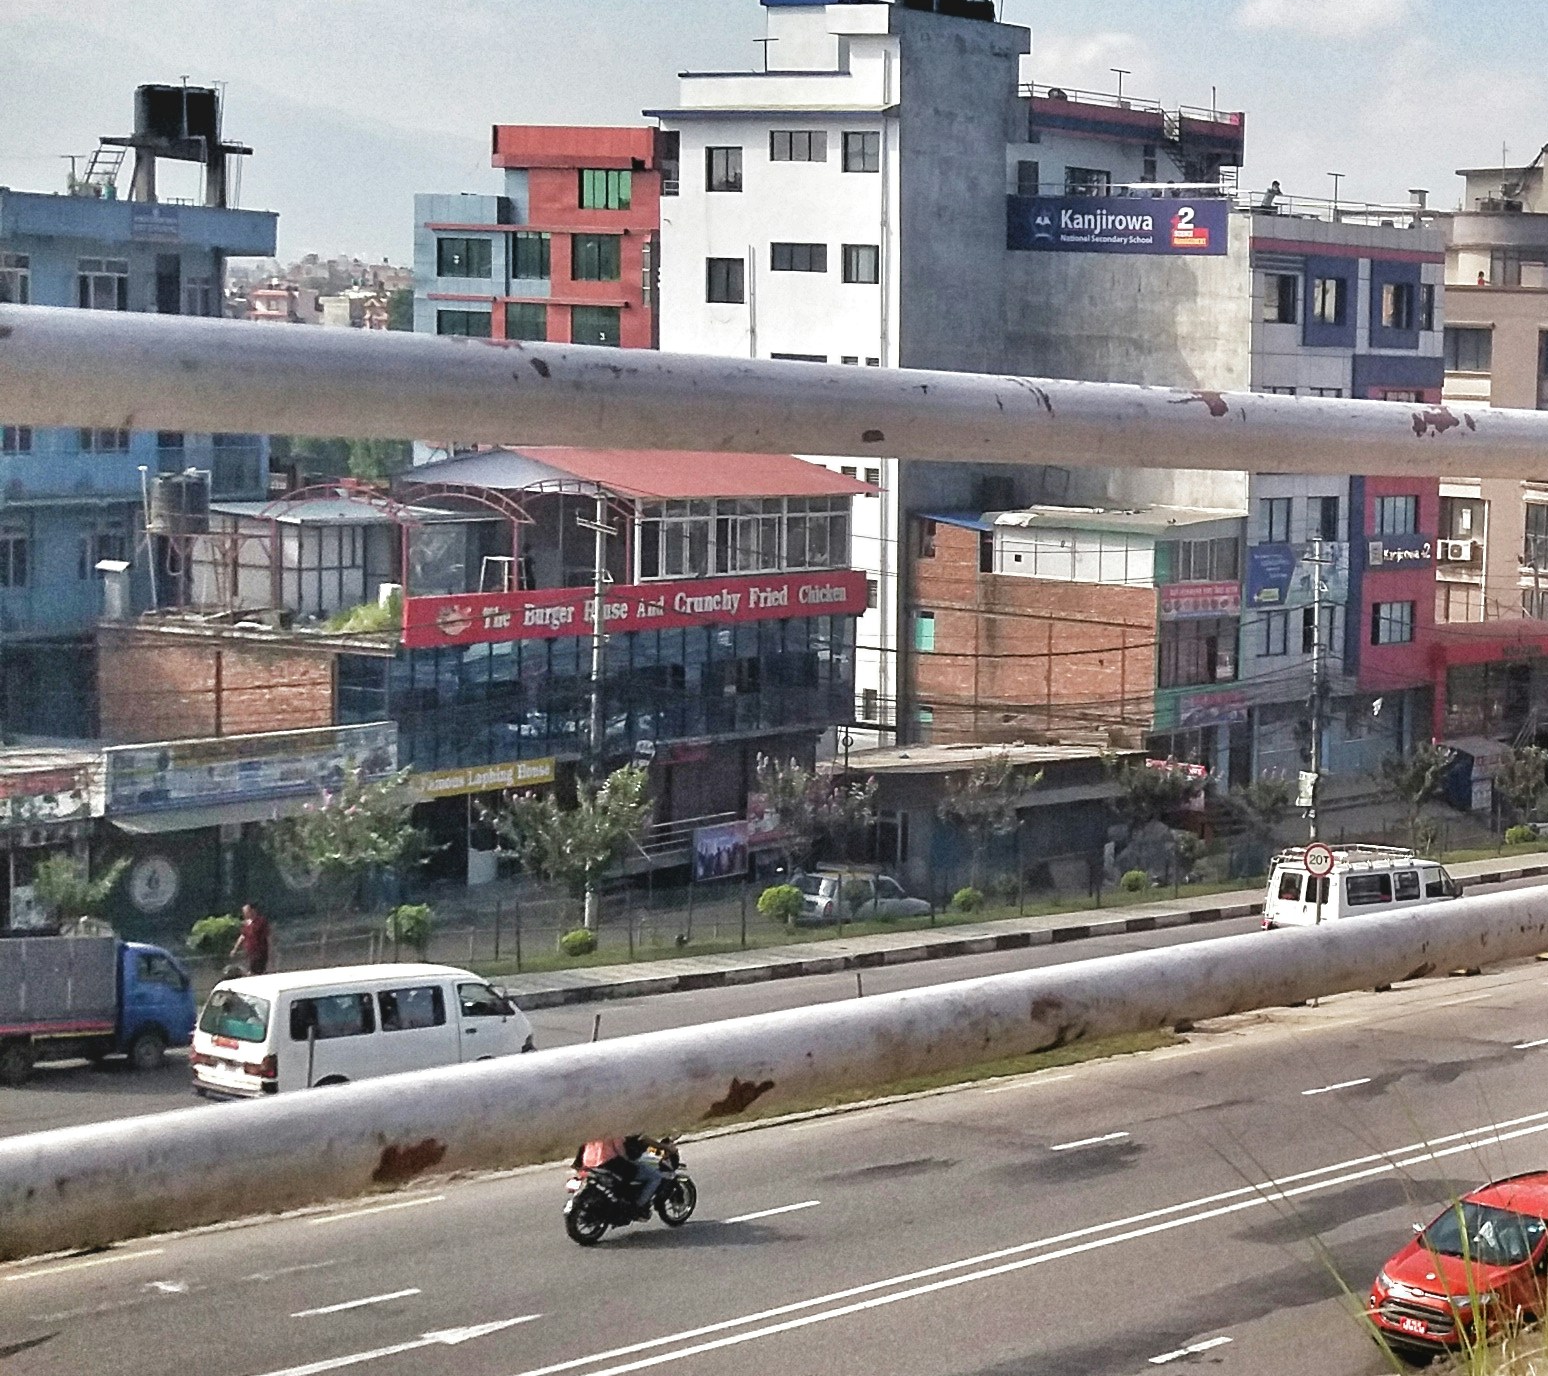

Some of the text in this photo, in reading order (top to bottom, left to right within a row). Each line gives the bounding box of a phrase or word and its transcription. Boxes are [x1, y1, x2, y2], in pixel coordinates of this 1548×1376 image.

[1061, 209, 1153, 234] Kanjirowa
[1060, 234, 1153, 244] National Secondary School
[482, 583, 847, 630] The Burger Huse And Crunchy Fried Chicken
